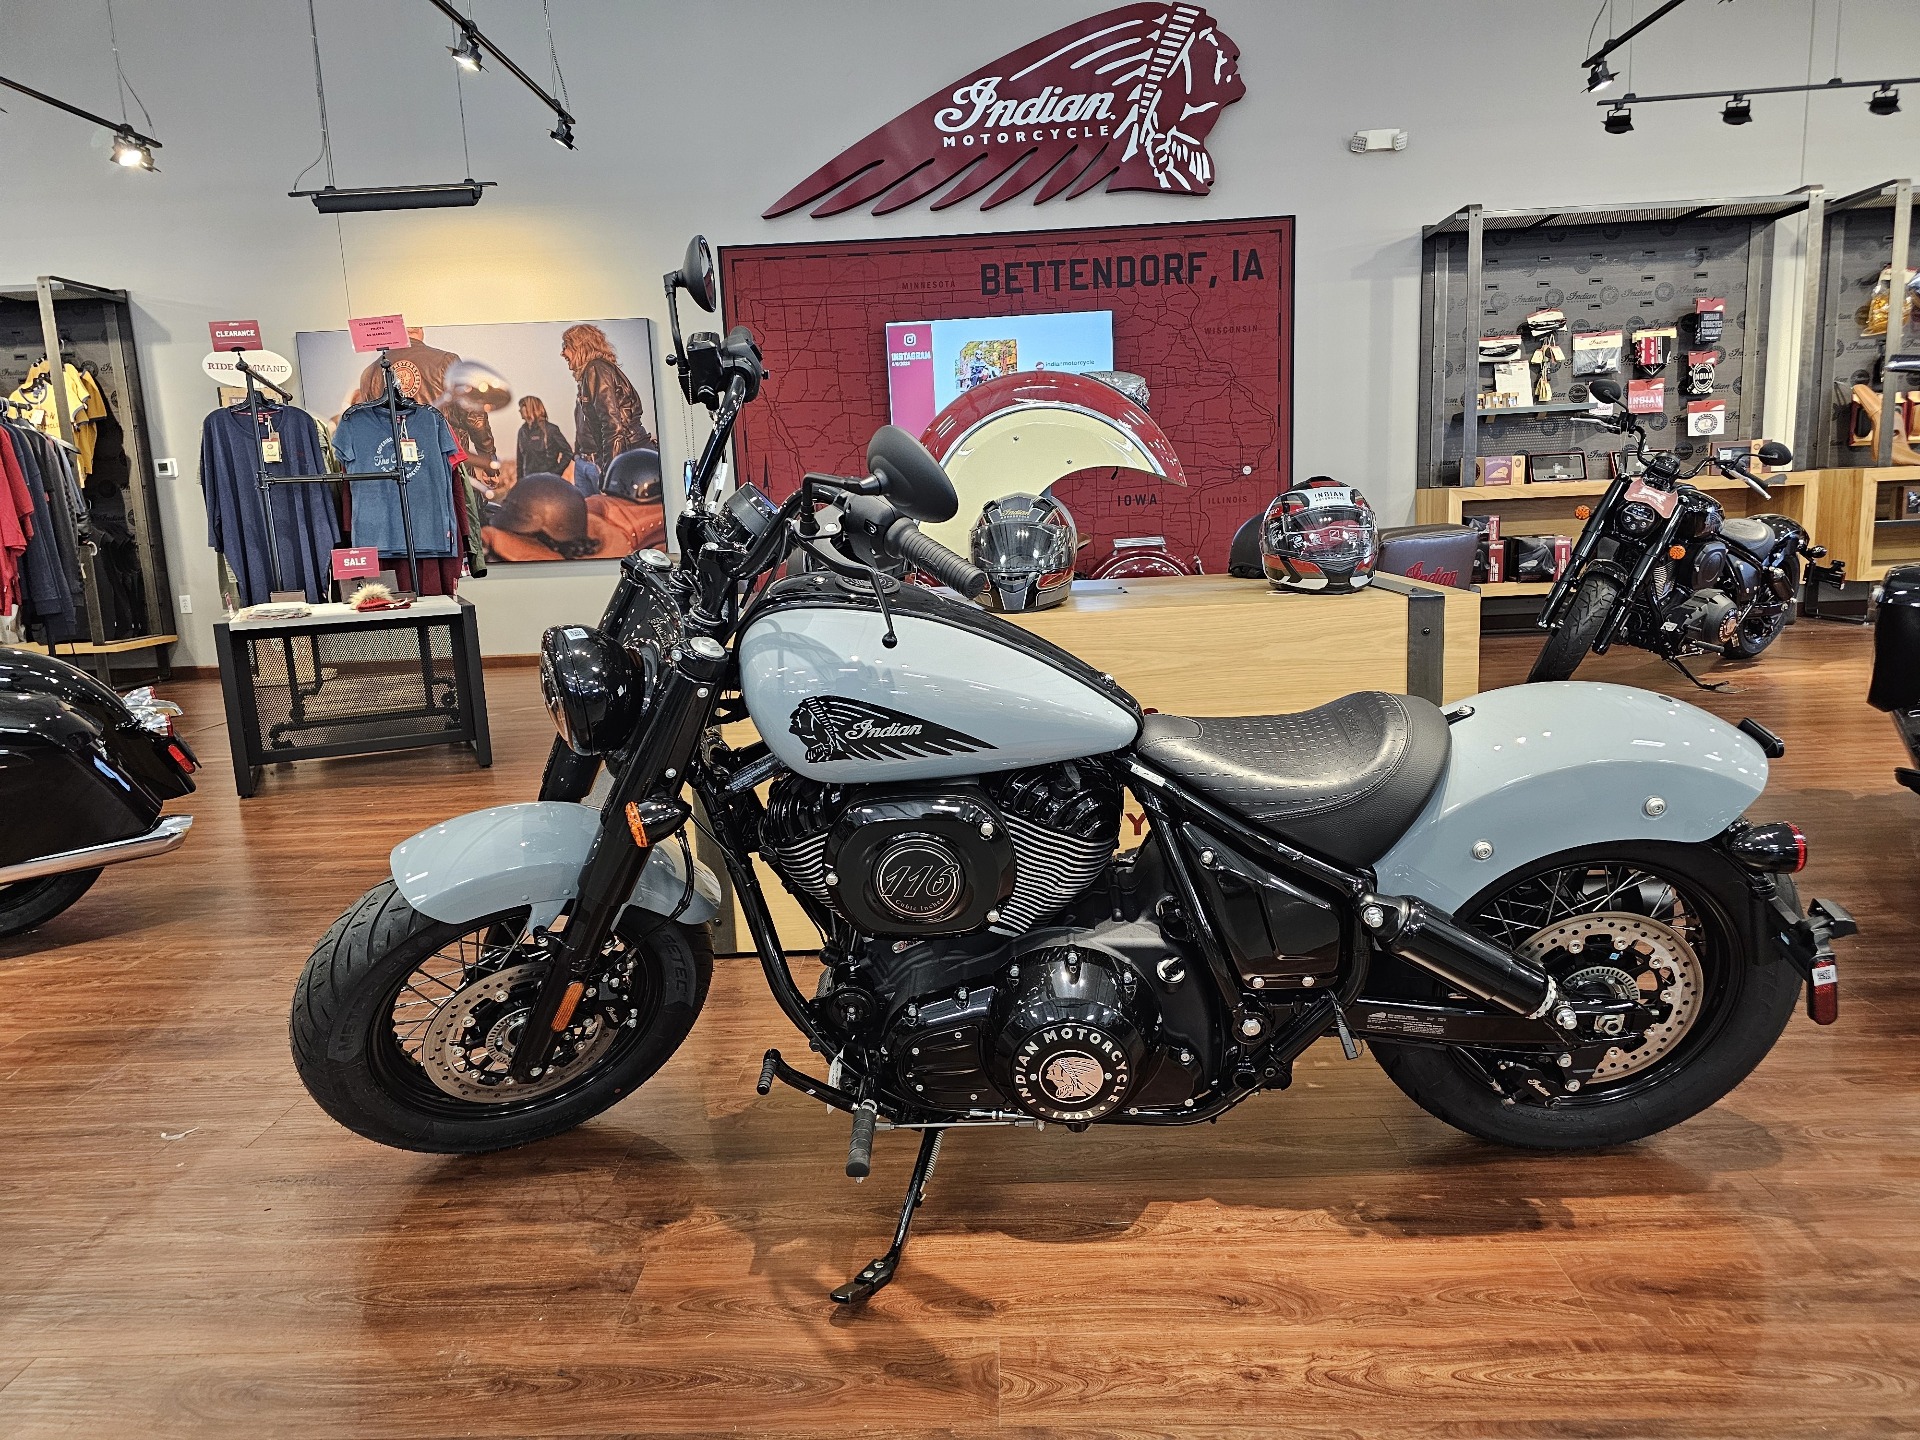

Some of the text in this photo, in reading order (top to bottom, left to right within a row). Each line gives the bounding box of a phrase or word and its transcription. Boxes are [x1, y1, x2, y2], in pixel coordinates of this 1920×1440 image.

[943, 125, 1109, 148] MOTORCYCLE
[1232, 248, 1264, 281] IA
[901, 279, 957, 290] MINNESOTA
[215, 329, 256, 338] CLEARANCE
[1204, 323, 1260, 335] WISCONSIN
[207, 362, 234, 372] RIDE
[1629, 395, 1663, 405] INDIAN
[1116, 494, 1158, 507] IOWA
[1207, 496, 1248, 505] ILLINOIS
[343, 556, 367, 567] SALE
[1405, 561, 1459, 587] Indian
[845, 719, 923, 740] Indian
[881, 863, 960, 898] 116
[895, 898, 944, 912] Cubic Inches
[1043, 1027, 1128, 1103] MOTORCYCLE
[1015, 1041, 1040, 1104] INDIAN
[1527, 1079, 1551, 1097] Indian
